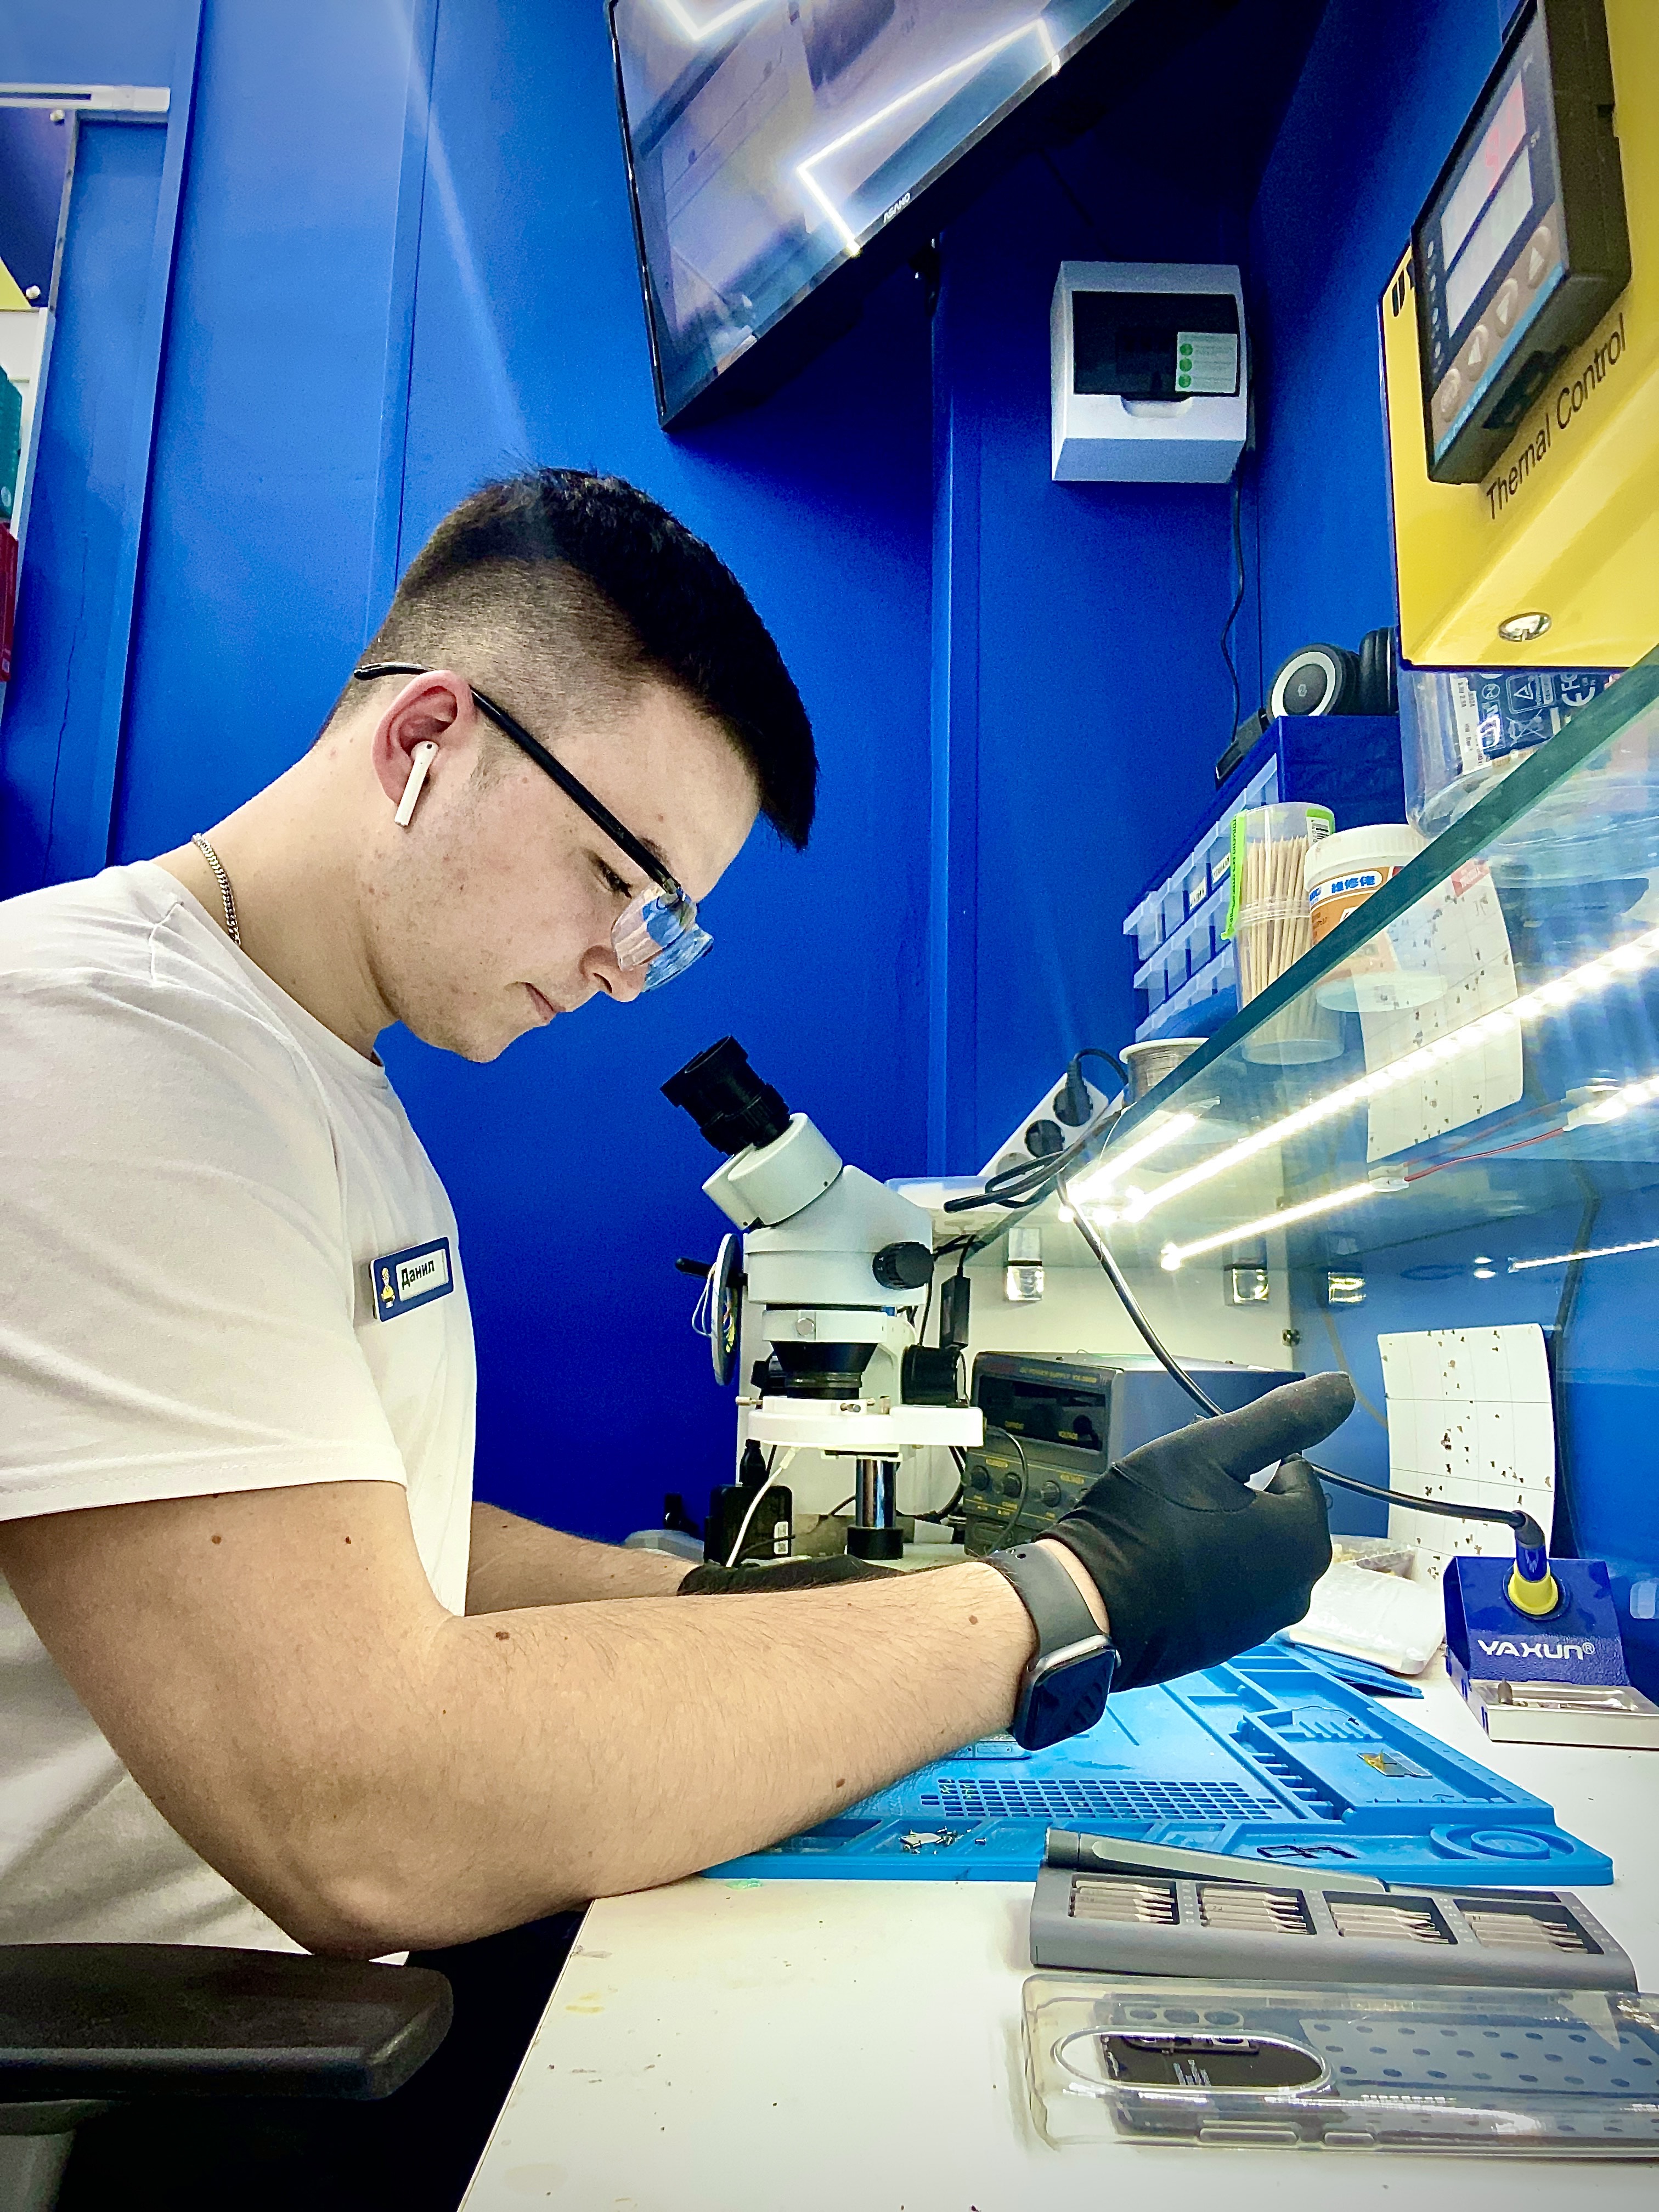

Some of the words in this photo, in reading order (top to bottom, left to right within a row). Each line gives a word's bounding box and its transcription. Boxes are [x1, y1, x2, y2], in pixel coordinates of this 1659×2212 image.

[883, 193, 911, 223] ASANO
[1556, 312, 1626, 430] Control
[401, 1260, 435, 1290] Данил
